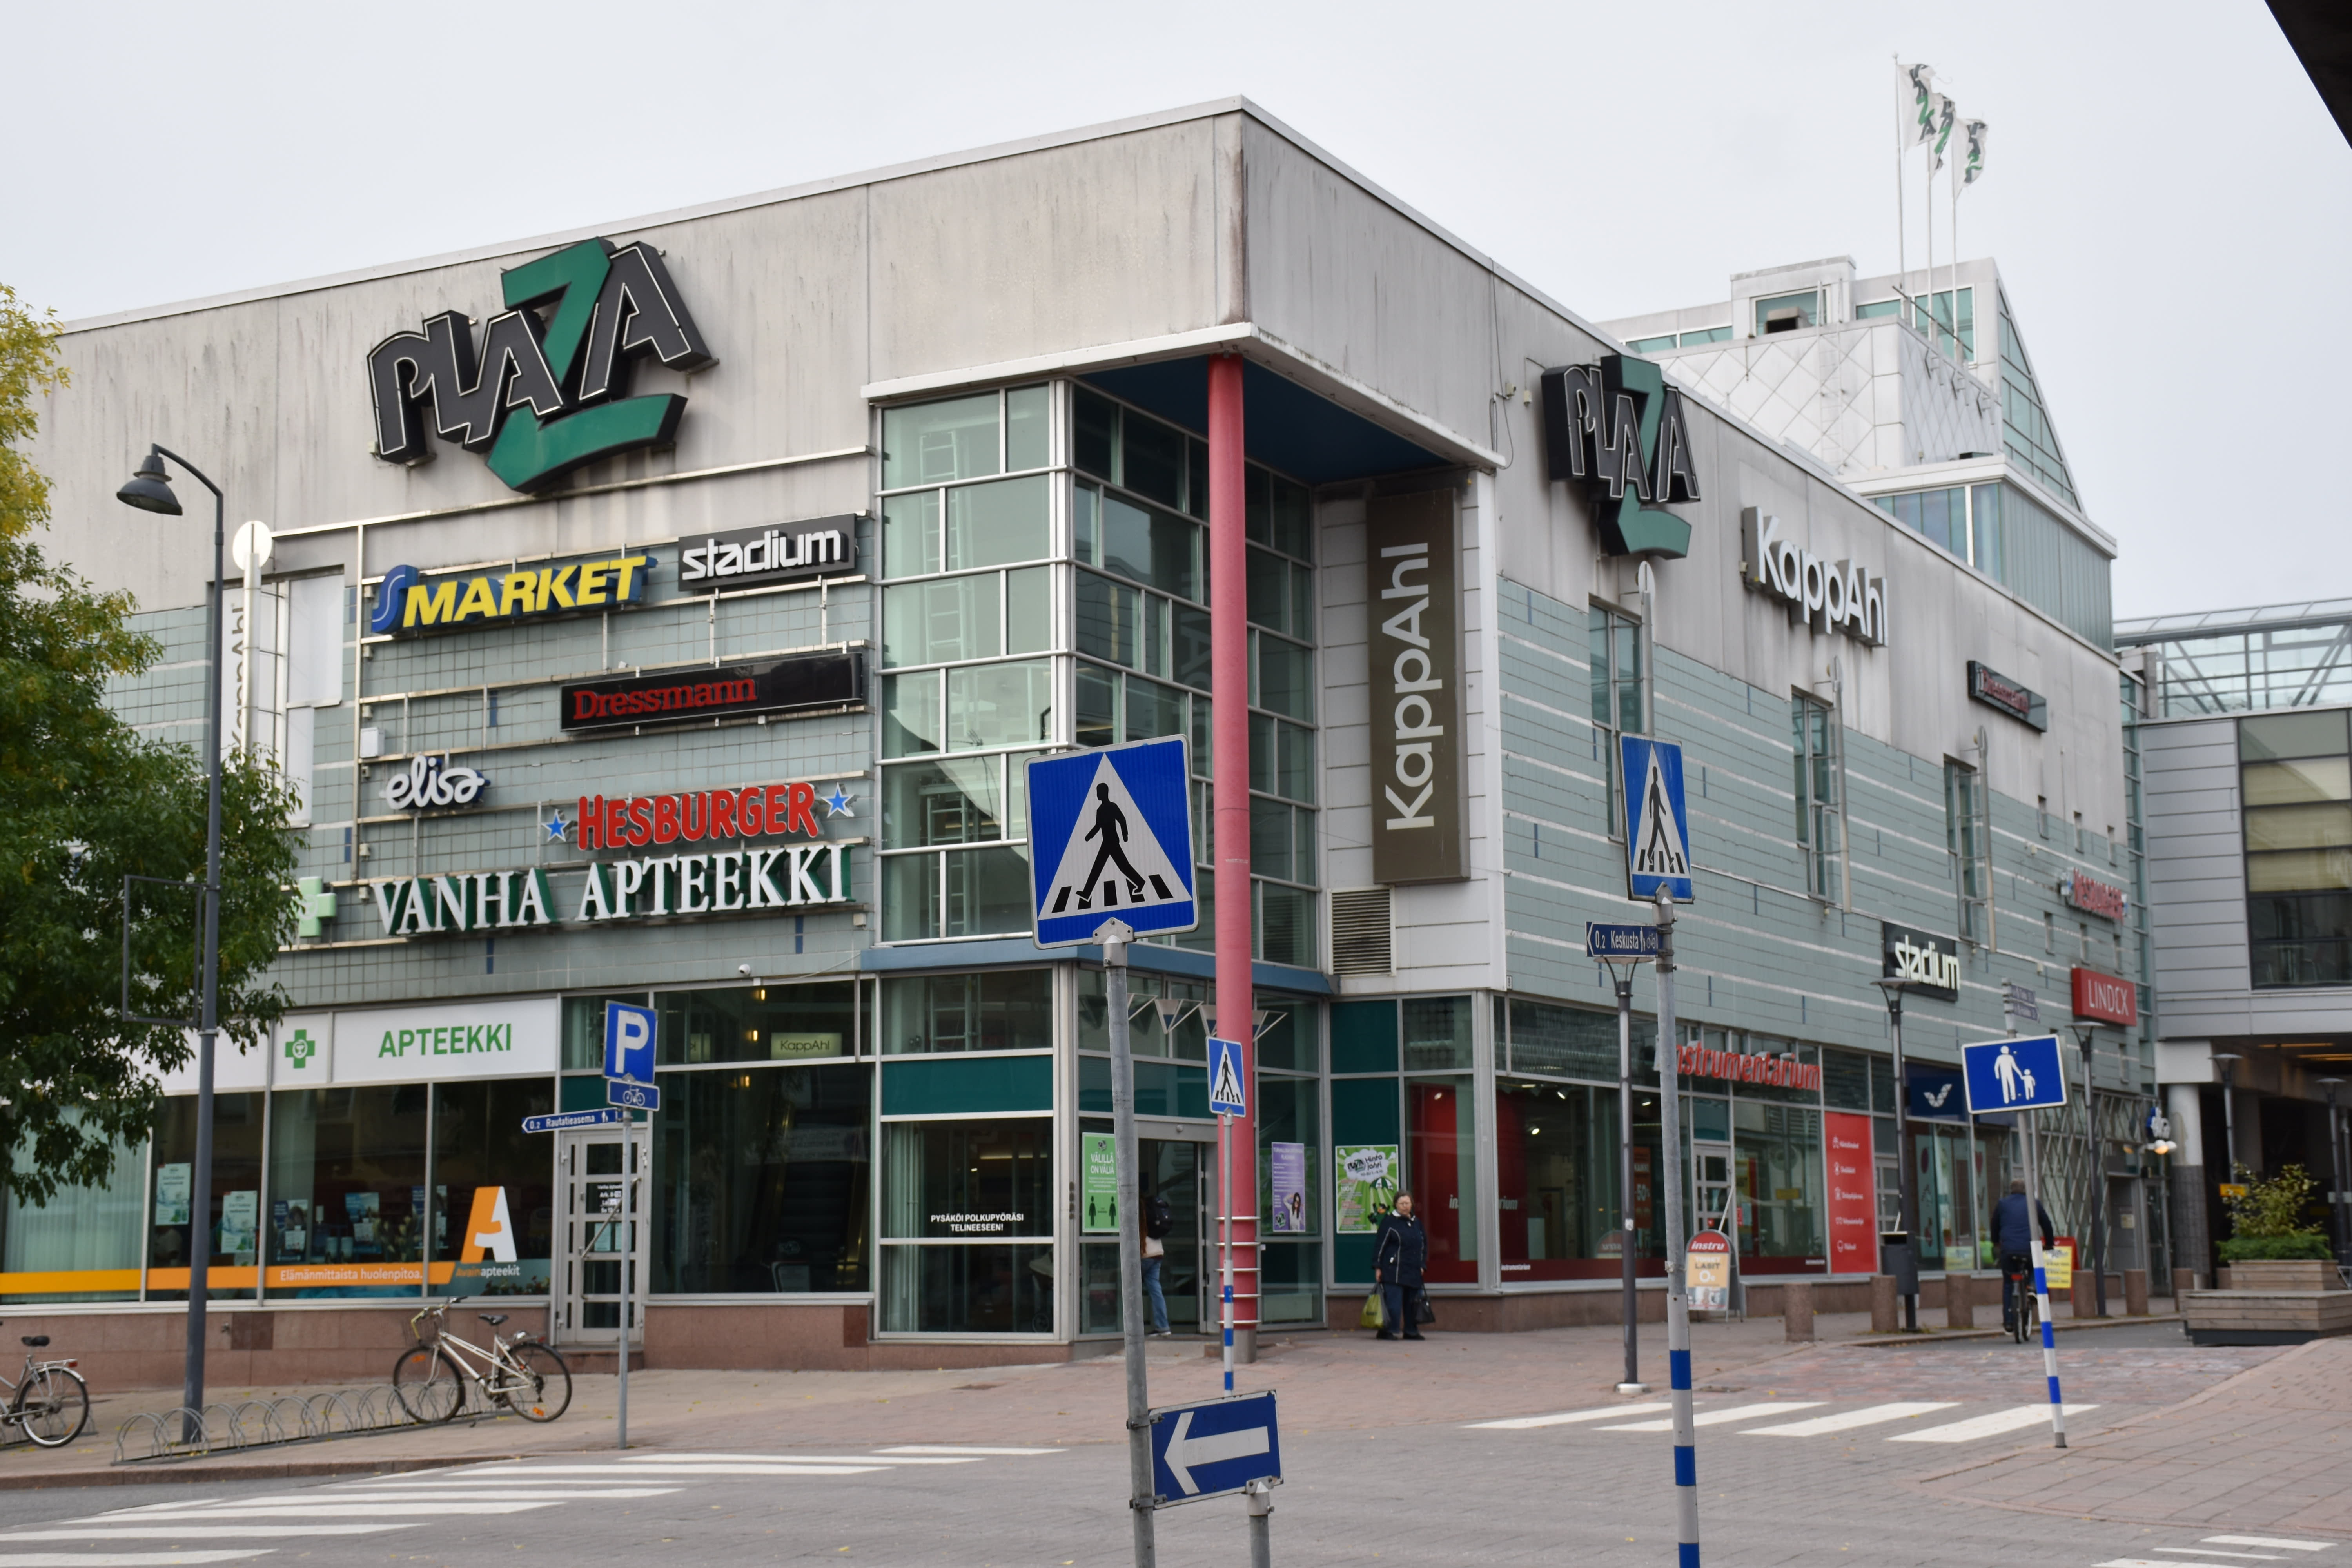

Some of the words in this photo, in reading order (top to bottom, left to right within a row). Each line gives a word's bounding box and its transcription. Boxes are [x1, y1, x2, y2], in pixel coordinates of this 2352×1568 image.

[367, 237, 706, 492] PLAZA
[1558, 354, 1700, 559] PLAZA
[682, 529, 841, 581] stadium
[1756, 506, 1888, 647] KappAhl
[573, 678, 757, 720] Dressmann
[1381, 543, 1443, 830] KappAhl
[379, 755, 486, 810] elisa
[577, 782, 819, 850] HESBURGER
[371, 869, 556, 935] VANHA
[576, 844, 851, 922] APTEEKKI
[1595, 930, 1605, 949] 0,2
[1611, 930, 1639, 949] Keskusta
[1895, 935, 1960, 991] stadium
[2088, 979, 2129, 1016] LINDEX
[378, 1023, 512, 1058] APTEEKKI
[615, 1009, 649, 1074] P
[780, 1040, 829, 1053] KappAhl
[1676, 1041, 1820, 1091] nstrumentarium
[546, 1115, 595, 1127] Rautatieasema
[1091, 1152, 1114, 1163] VÄLILLÄ
[1091, 1165, 1098, 1174] ON
[1365, 1155, 1383, 1163] Hinta
[931, 1213, 963, 1222] PYSÄKÖI
[965, 1212, 1024, 1222] POLKUPYÖRÄSI
[951, 1223, 1004, 1232] TELINEESEEN!
[1691, 1241, 1725, 1250] instru
[280, 1267, 358, 1281] Elämänmittaista
[361, 1265, 423, 1281] huolenpitoa.
